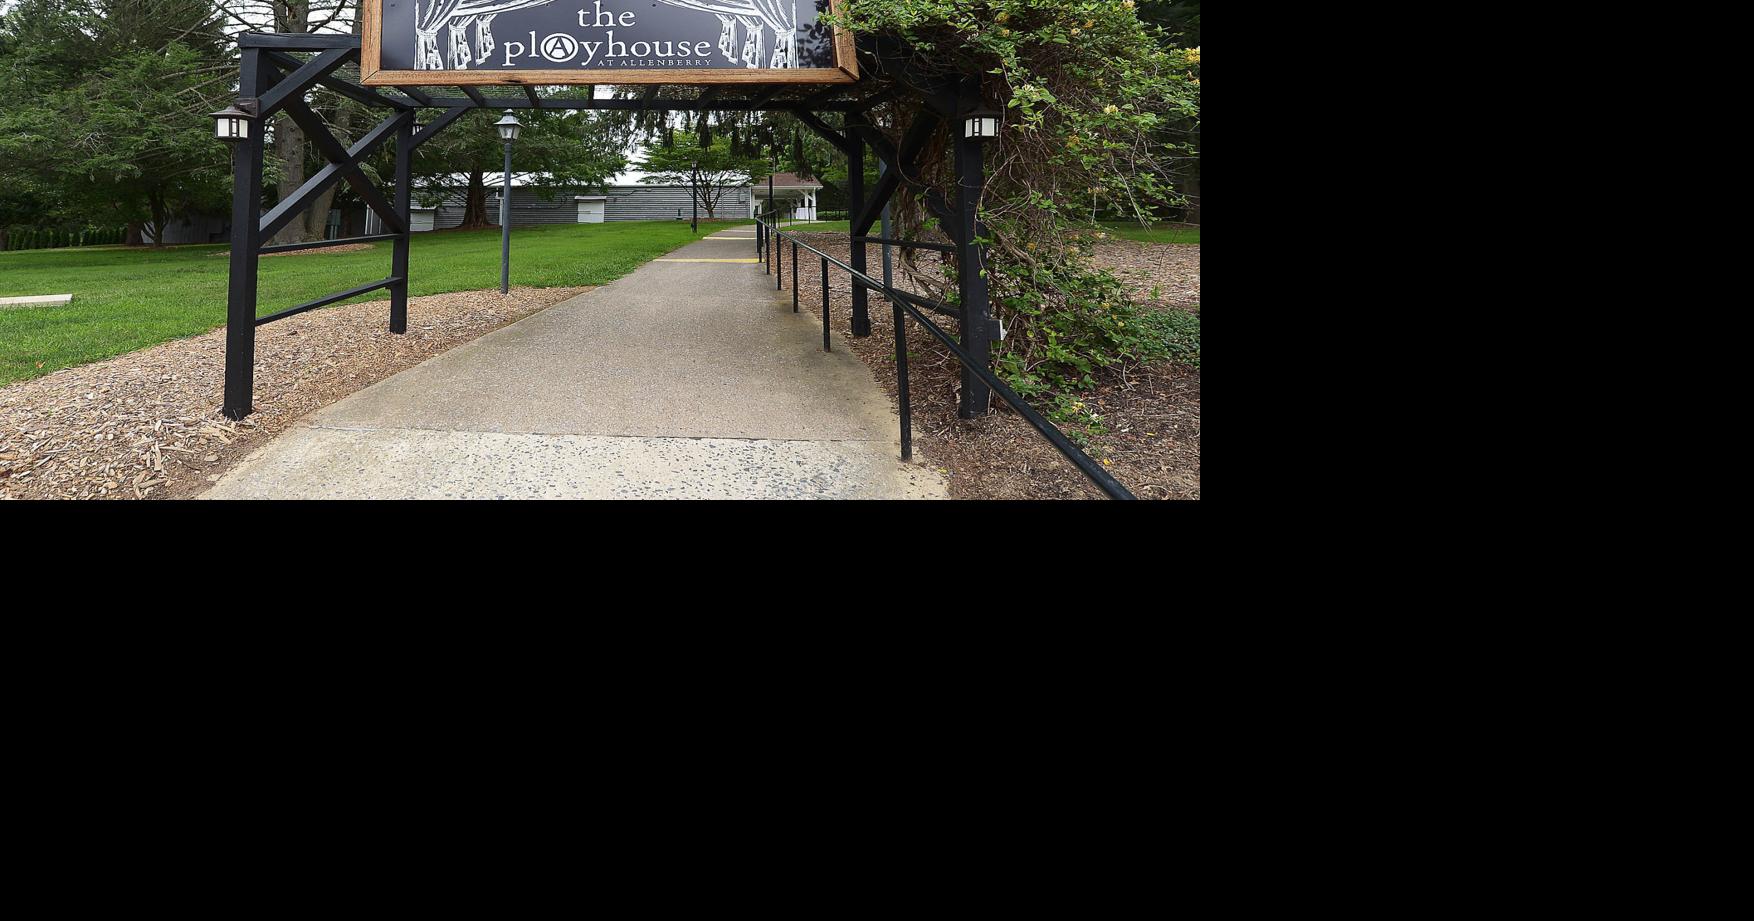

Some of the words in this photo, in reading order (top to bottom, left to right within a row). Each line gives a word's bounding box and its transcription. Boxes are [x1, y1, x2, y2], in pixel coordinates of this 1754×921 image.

[577, 0, 636, 27] the
[598, 59, 614, 67] AT
[621, 59, 712, 67] ALLENBERRY
